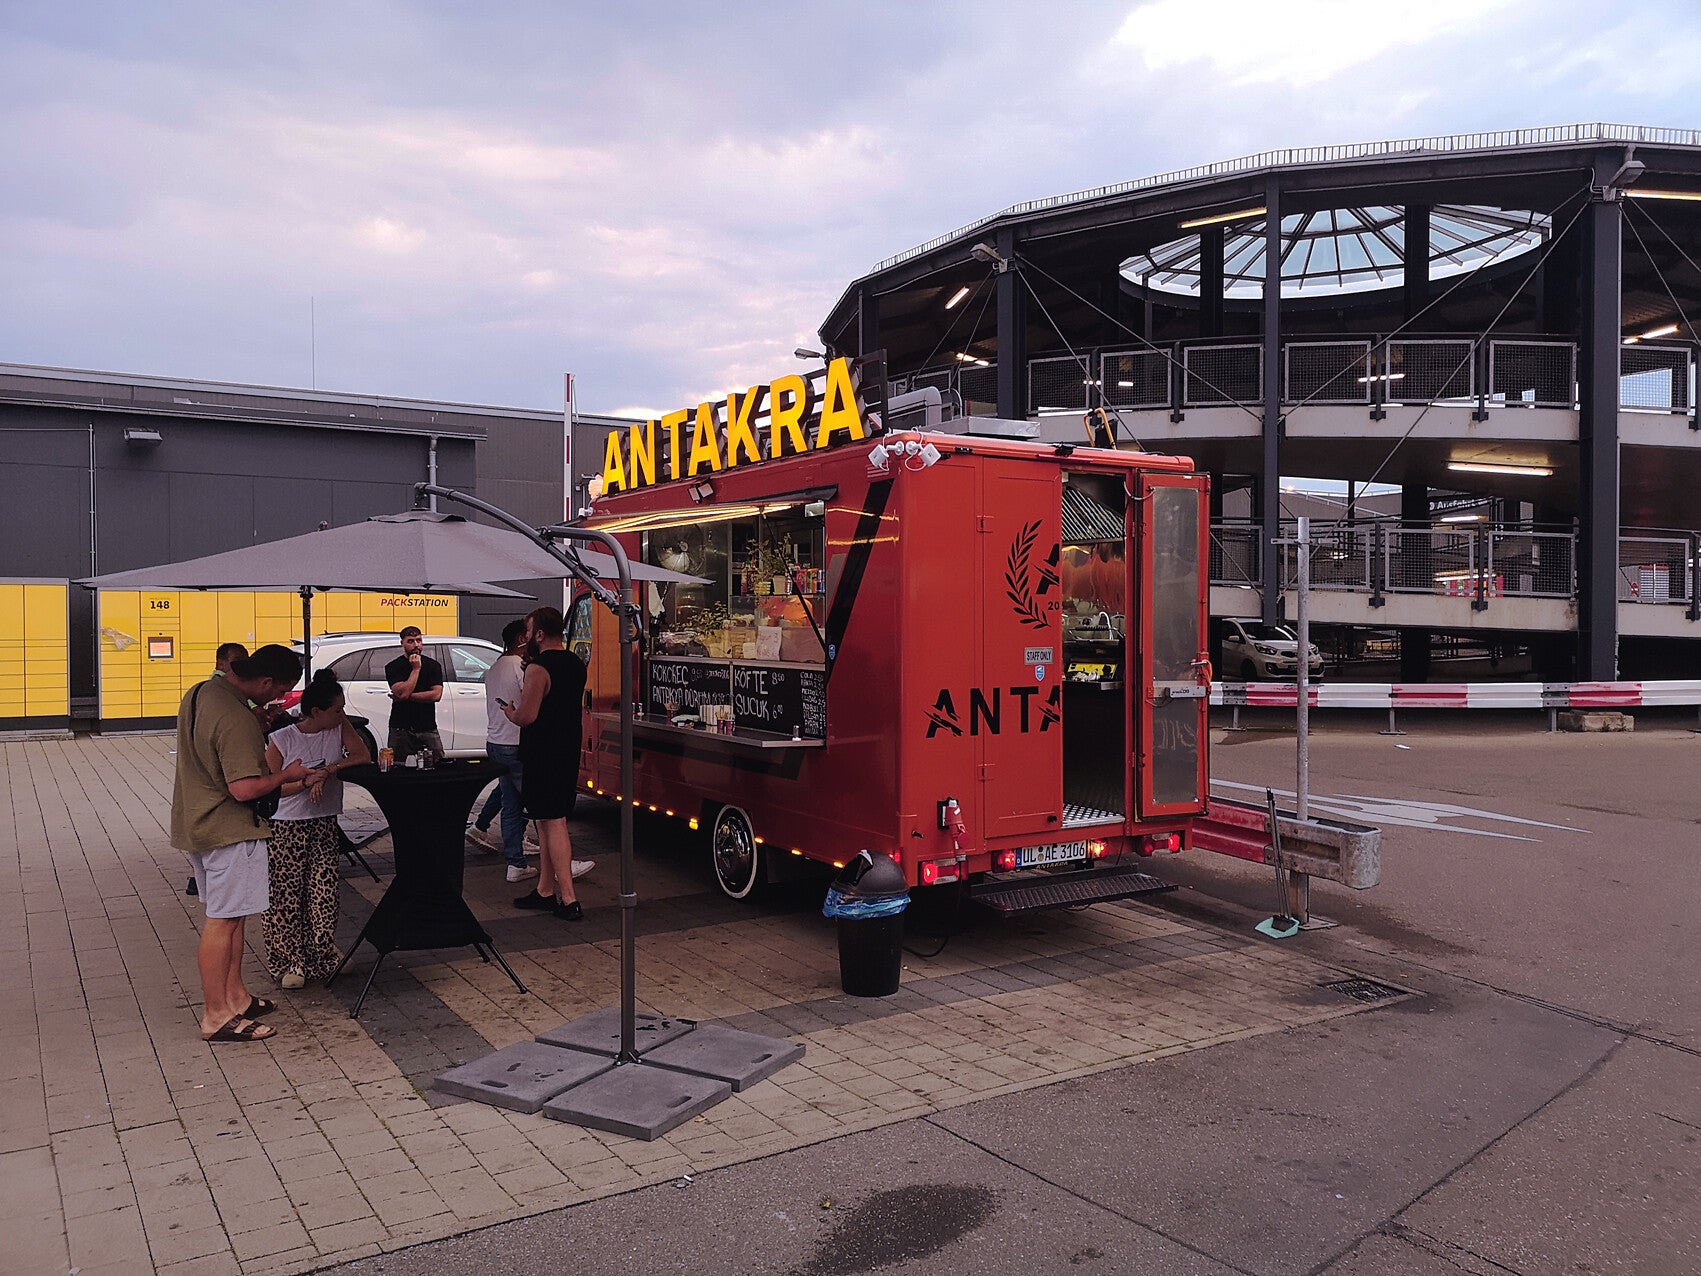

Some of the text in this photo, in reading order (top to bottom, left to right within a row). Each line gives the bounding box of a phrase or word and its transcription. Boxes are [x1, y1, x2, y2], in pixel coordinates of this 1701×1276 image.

[602, 356, 864, 495] ANTAKRA
[150, 600, 170, 609] 148
[380, 598, 449, 607] PACKSTATION
[1026, 651, 1052, 661] STAFF ONLY
[734, 667, 769, 695] KÖFTE
[799, 671, 814, 679] COLA
[735, 693, 770, 721] SUCUK
[1023, 848, 1036, 863] UL
[1044, 845, 1058, 861] AE
[1060, 842, 1085, 859] 3106
